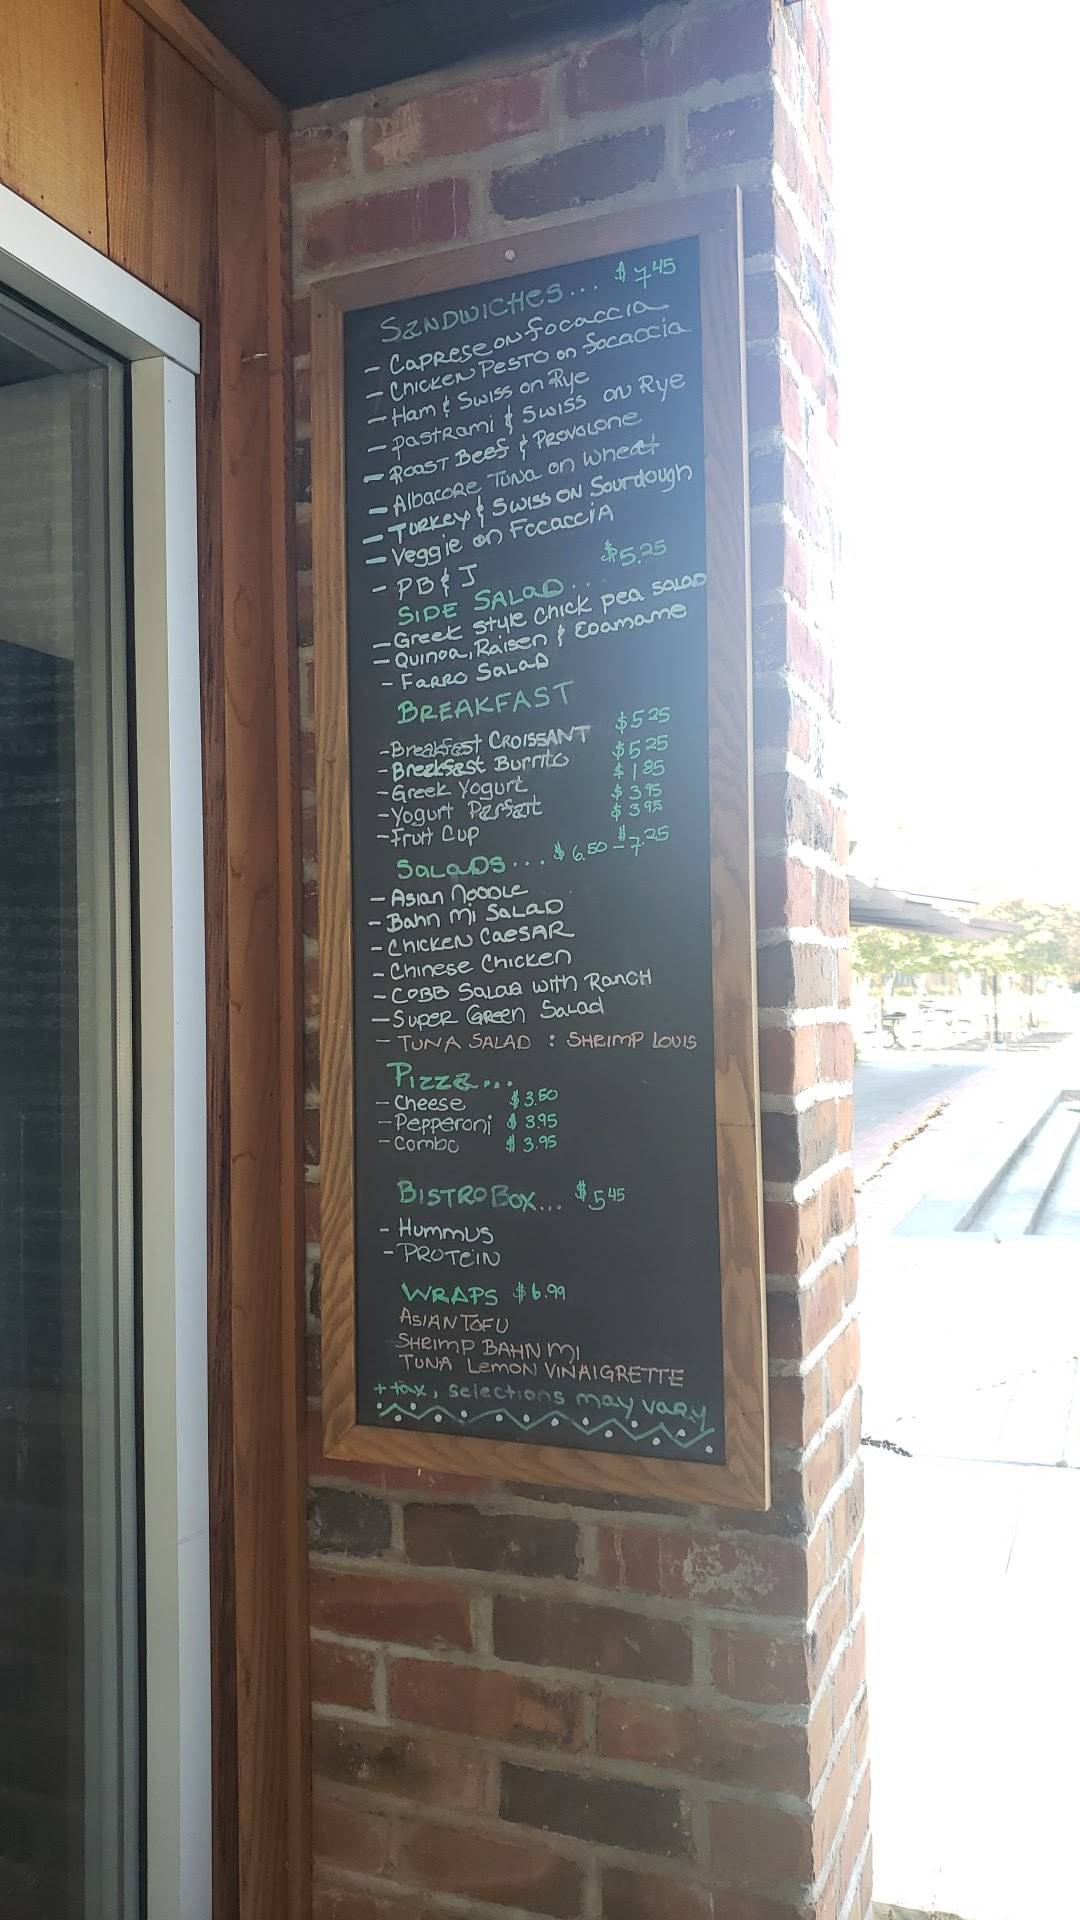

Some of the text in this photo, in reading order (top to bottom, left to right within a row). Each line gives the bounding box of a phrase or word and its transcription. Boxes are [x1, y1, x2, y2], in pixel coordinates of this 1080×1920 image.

[392, 404, 436, 427] Ham
[458, 386, 513, 410] Swiss
[519, 378, 545, 395] on
[548, 368, 590, 394] Rye
[523, 394, 587, 424] Swiss
[638, 373, 686, 403] Rye
[548, 457, 575, 475] on
[492, 491, 552, 517] Swiss
[590, 463, 692, 497] Sourdough
[392, 534, 463, 567] Veggie
[472, 529, 503, 548] on
[397, 576, 435, 600] PB
[459, 563, 478, 588] J
[393, 625, 463, 649] Greek
[601, 588, 645, 614] pea
[398, 602, 458, 626] SIDE
[397, 680, 574, 724] BREAKFAST
[390, 733, 483, 758] Breakfast
[489, 725, 591, 750] CROISSANT
[391, 756, 485, 782] Breakfast
[494, 750, 570, 772] Burrito
[391, 782, 451, 803] Greek
[459, 775, 528, 800] Yogurt
[391, 803, 454, 827] Yogurt
[390, 827, 434, 848] Fruit
[442, 825, 480, 847] Cup
[391, 889, 444, 908] Asian
[387, 913, 440, 933] Bahn
[390, 960, 474, 981] Chinese
[397, 1035, 462, 1053] TUNA
[469, 1033, 531, 1049] SALAD
[567, 1031, 643, 1048] SHRIMP
[653, 1031, 697, 1049] LOUIS
[394, 1094, 466, 1112] Cheese
[395, 1113, 493, 1135] Pepperoni
[394, 1136, 459, 1153] Combo
[397, 1180, 487, 1208] BISTRO
[399, 1217, 494, 1244] Hummus
[401, 1282, 498, 1306] WRAPS
[400, 1307, 509, 1333] ASIAN TOFU
[482, 1339, 541, 1360] BAHN
[399, 1354, 452, 1371] TUNA
[544, 1362, 685, 1387] VINAIGRETTE
[449, 1382, 565, 1405] selections
[576, 1392, 633, 1419] may
